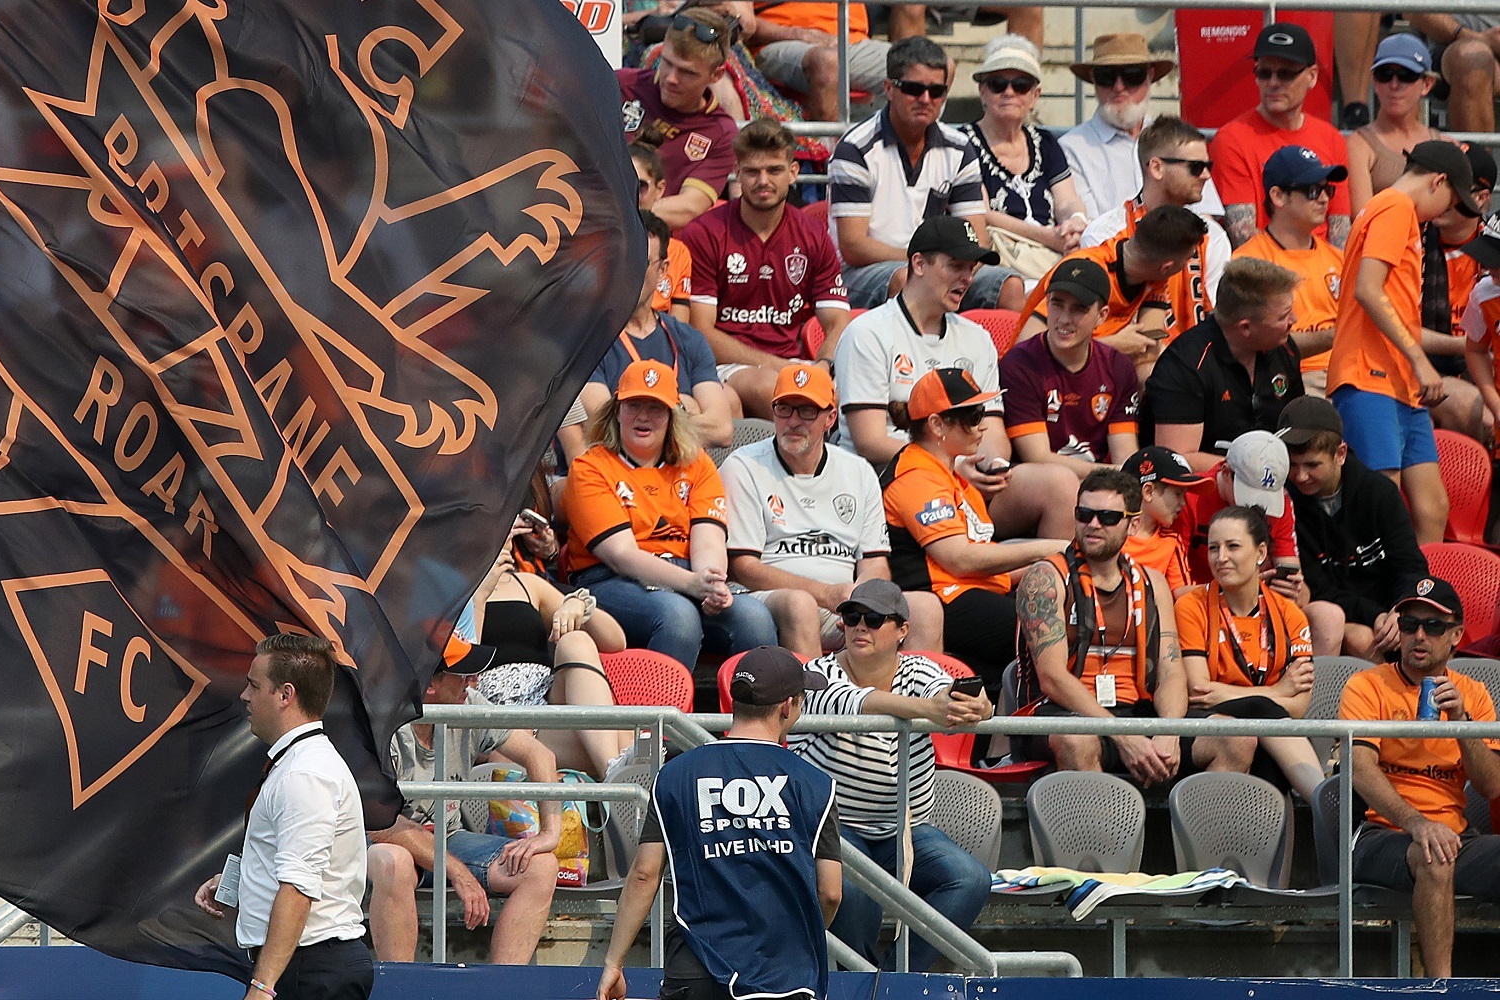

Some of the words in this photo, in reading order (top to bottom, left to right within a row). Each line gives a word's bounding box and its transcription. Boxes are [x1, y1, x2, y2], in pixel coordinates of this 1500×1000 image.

[1200, 26, 1248, 37] REMONDIS
[720, 305, 792, 325] Steadfast
[73, 355, 220, 560] ROAR
[920, 506, 954, 524] Pauls
[74, 610, 151, 722] FC
[697, 775, 790, 819] FOX
[700, 817, 791, 833] SPORTS
[703, 839, 745, 859] LIVE
[748, 838, 767, 853] IN
[767, 839, 794, 854] HD
[557, 871, 579, 881] coles
